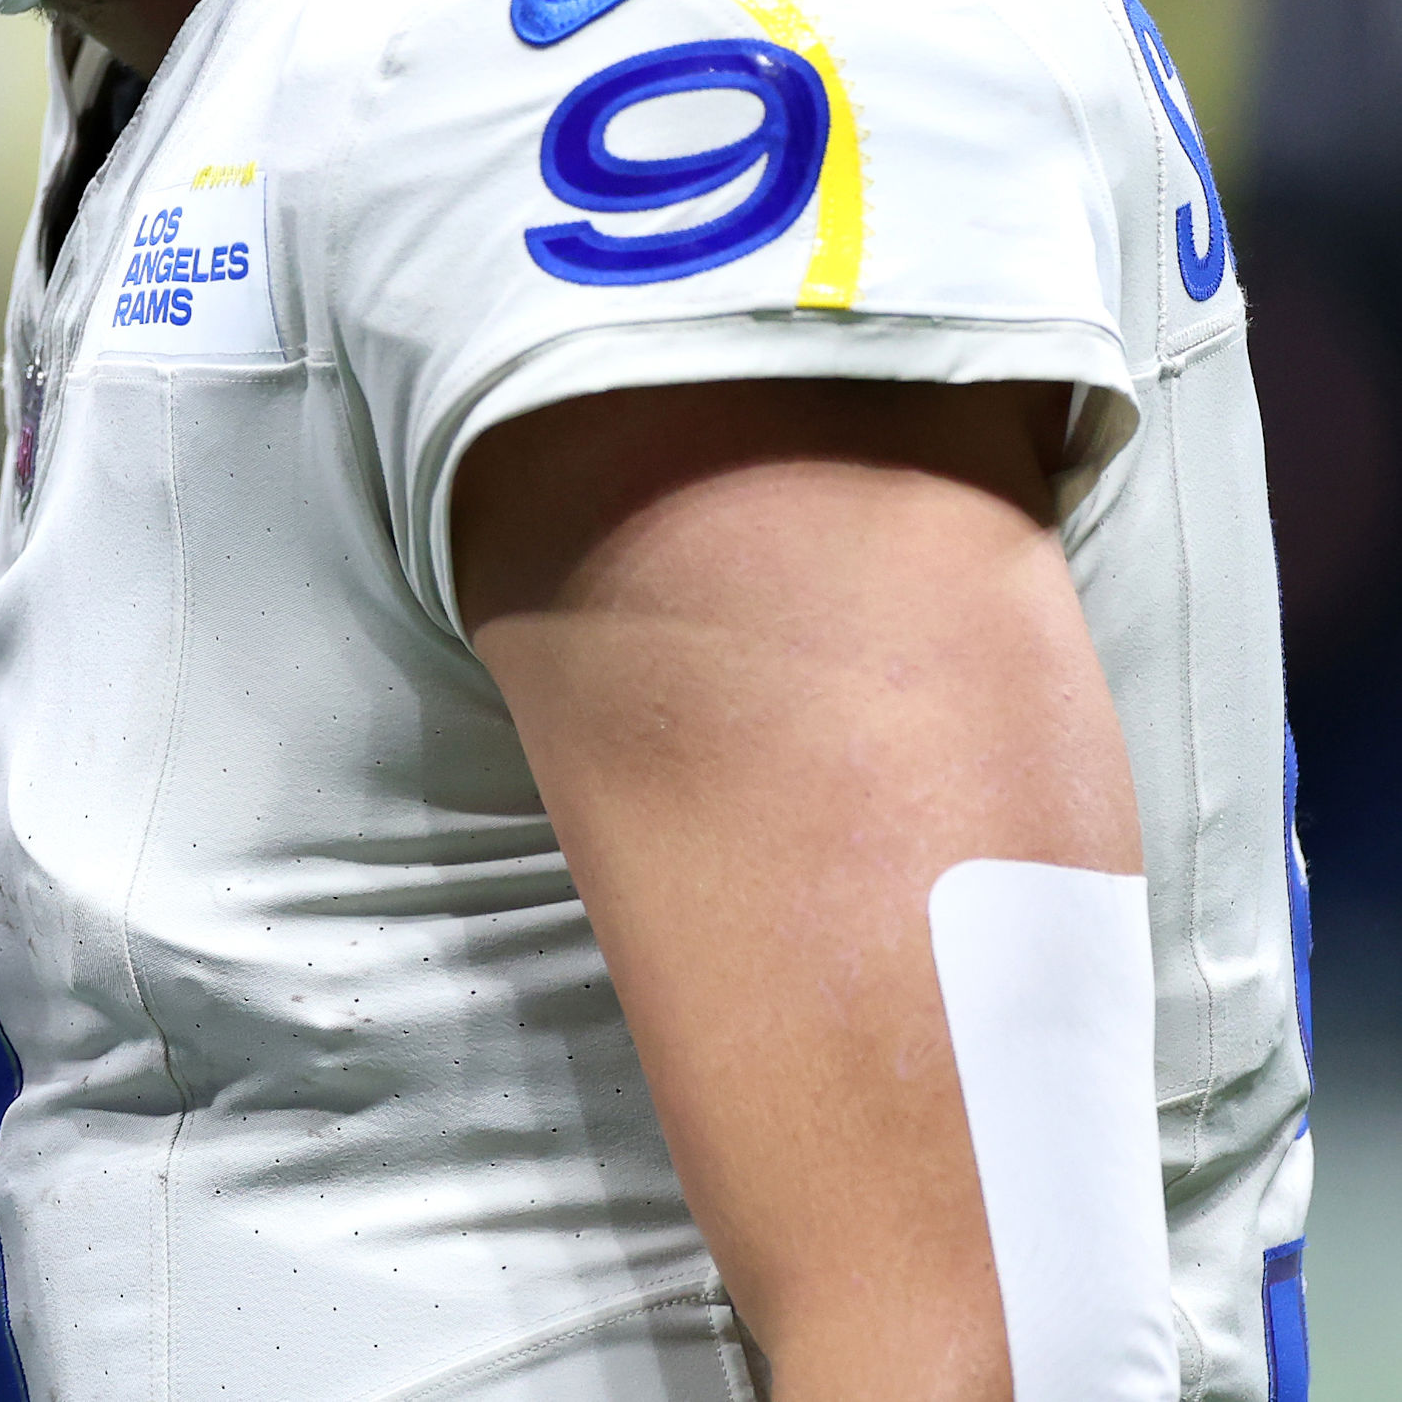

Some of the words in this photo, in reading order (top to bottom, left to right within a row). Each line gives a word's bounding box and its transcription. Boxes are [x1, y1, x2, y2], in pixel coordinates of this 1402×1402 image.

[524, 37, 830, 287] 9
[133, 206, 183, 248] LOS
[121, 241, 249, 288] ANGELES
[112, 288, 193, 328] RAMS
